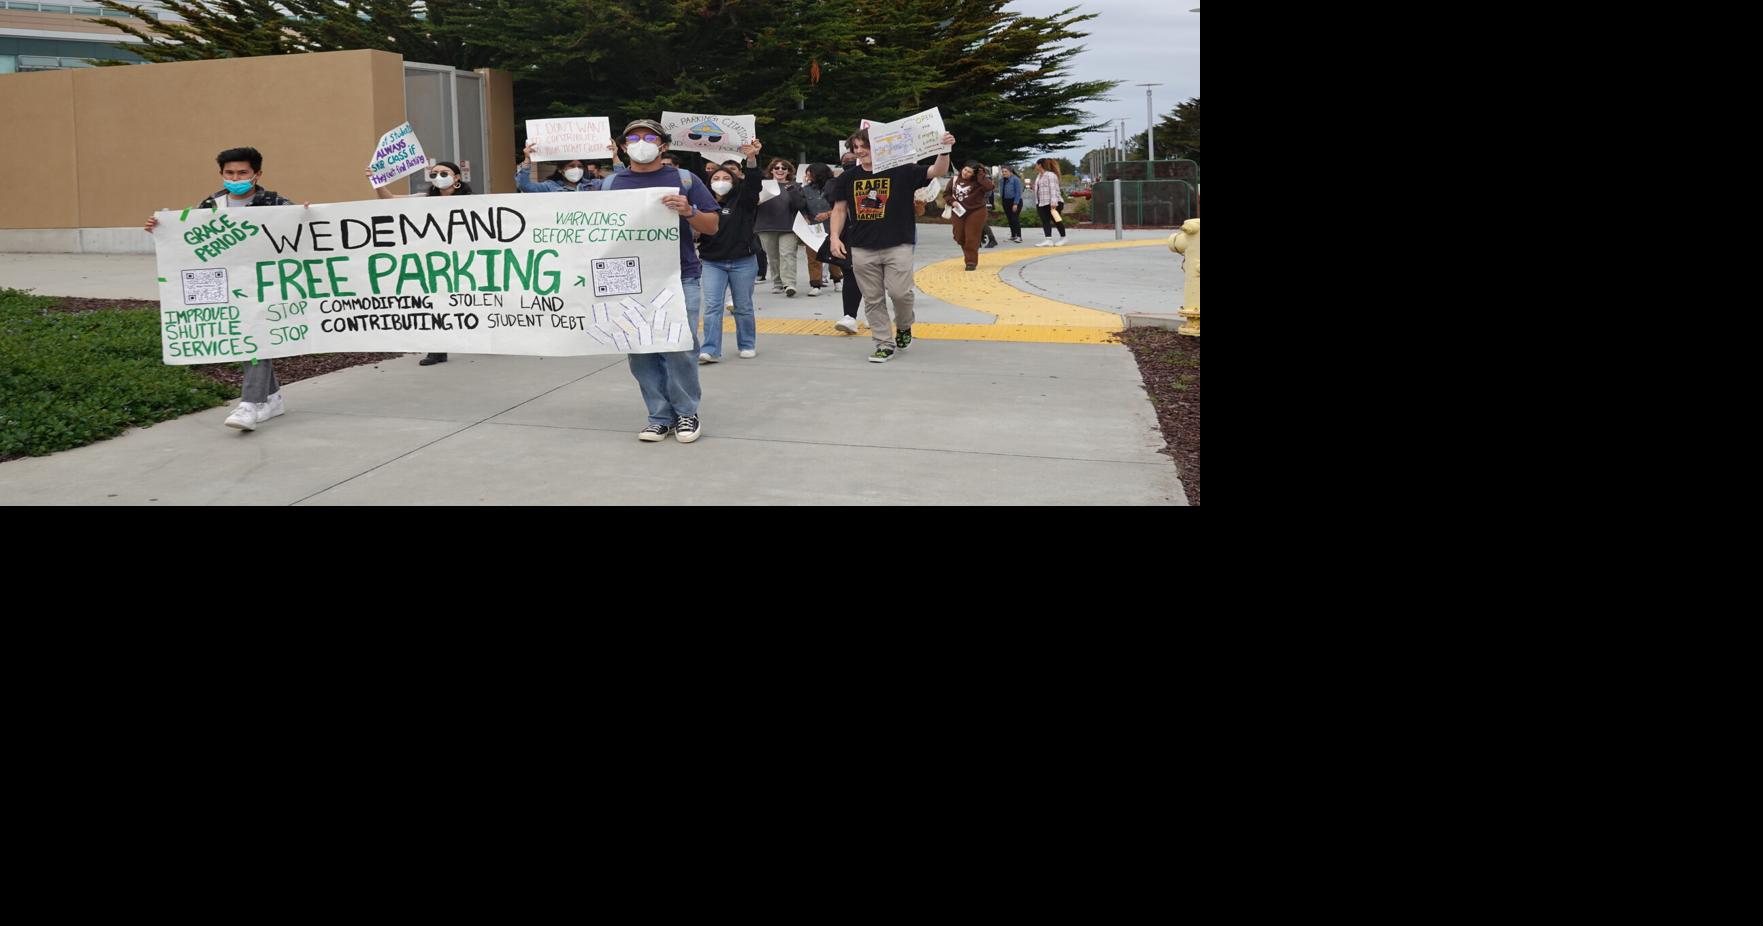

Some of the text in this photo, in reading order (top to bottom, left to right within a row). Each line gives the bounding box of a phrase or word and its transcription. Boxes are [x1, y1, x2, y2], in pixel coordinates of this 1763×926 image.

[376, 139, 407, 160] ALWAYS
[855, 180, 888, 190] RAGE
[183, 214, 237, 246] GRACE
[556, 211, 628, 227] WARNINGS
[194, 220, 260, 262] PERIODS
[262, 208, 526, 254] WE DEMAND
[533, 227, 680, 244] BEFORE CITATIONS
[256, 248, 561, 303] FREE PARKING
[165, 306, 240, 325] IMPROVED
[266, 293, 564, 322] STOP COMMODIFYING STOLEN LAND
[166, 320, 242, 340] SHUTTLE
[269, 313, 586, 345] STOP CONTRIBUTING TO STUDENT DEBT
[169, 335, 258, 357] SERVICES
